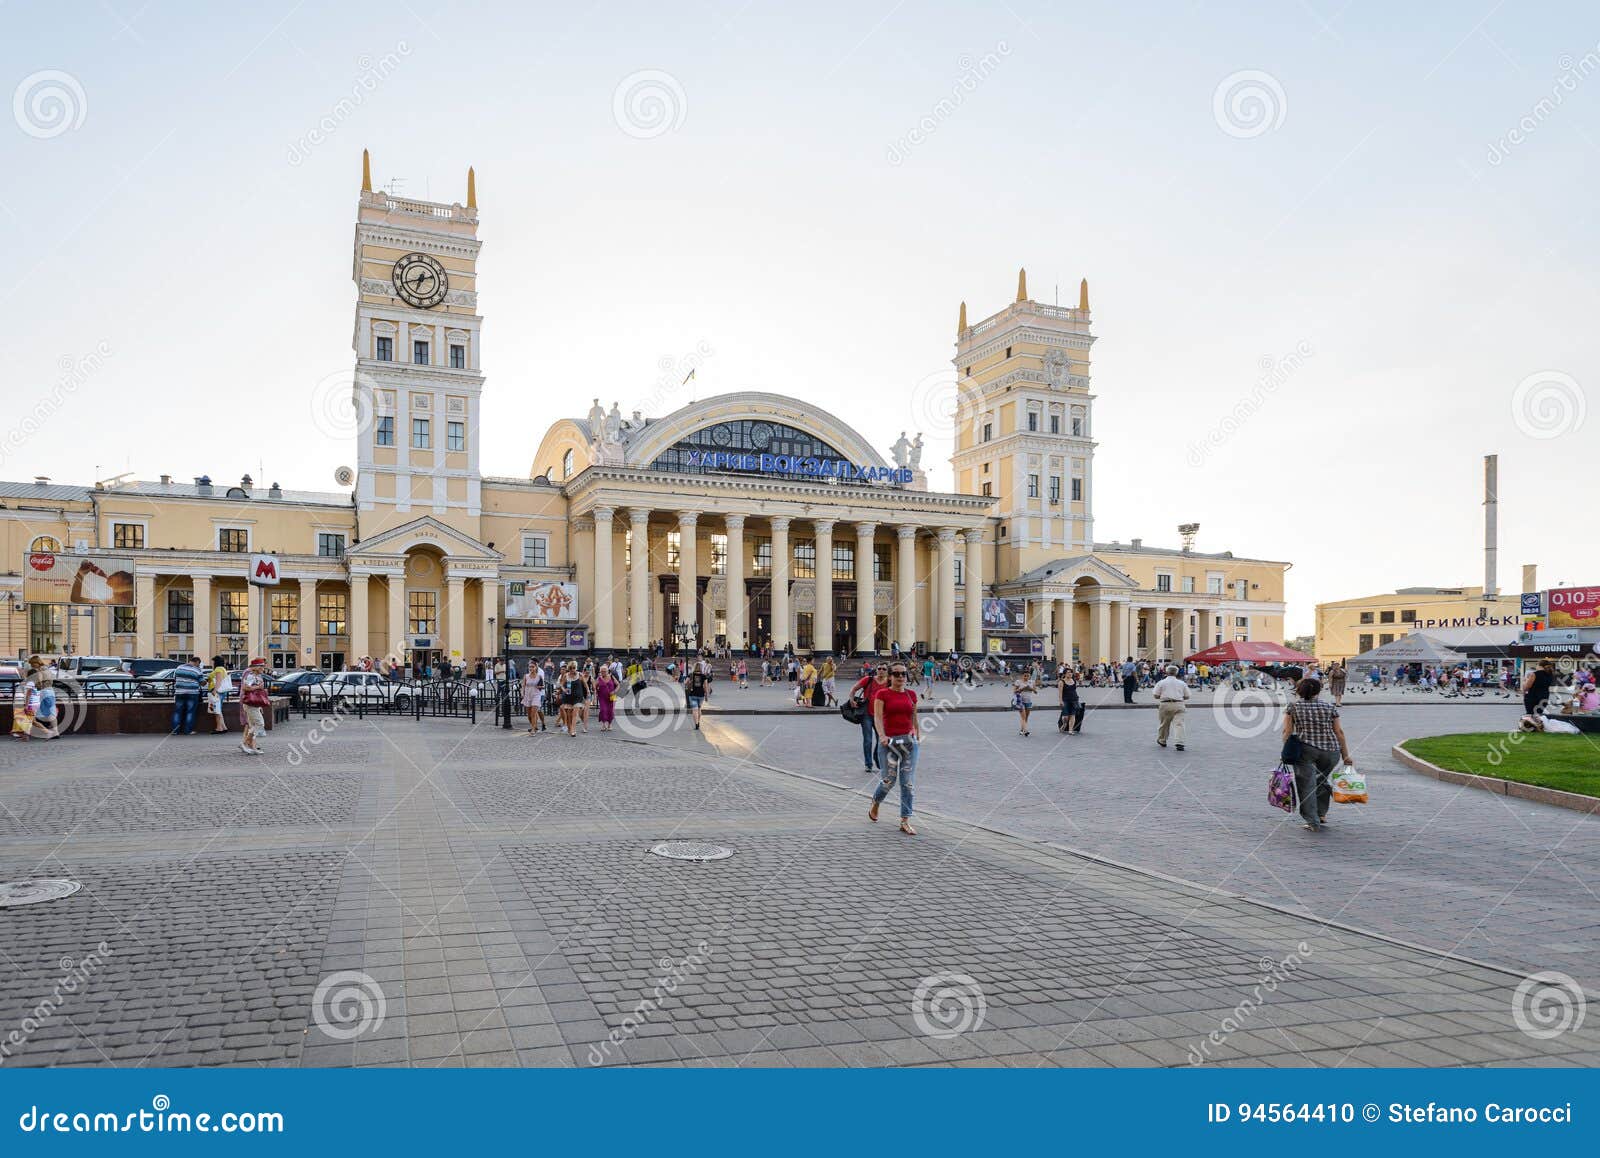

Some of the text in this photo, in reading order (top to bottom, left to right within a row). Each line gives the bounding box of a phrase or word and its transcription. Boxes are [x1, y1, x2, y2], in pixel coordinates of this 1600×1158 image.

[686, 451, 914, 483] ХАРКІВ ВОКЗАЛ ХАРКІВ
[1552, 592, 1585, 606] 0,10
[1414, 616, 1519, 629] ПРИМІСЬКІ
